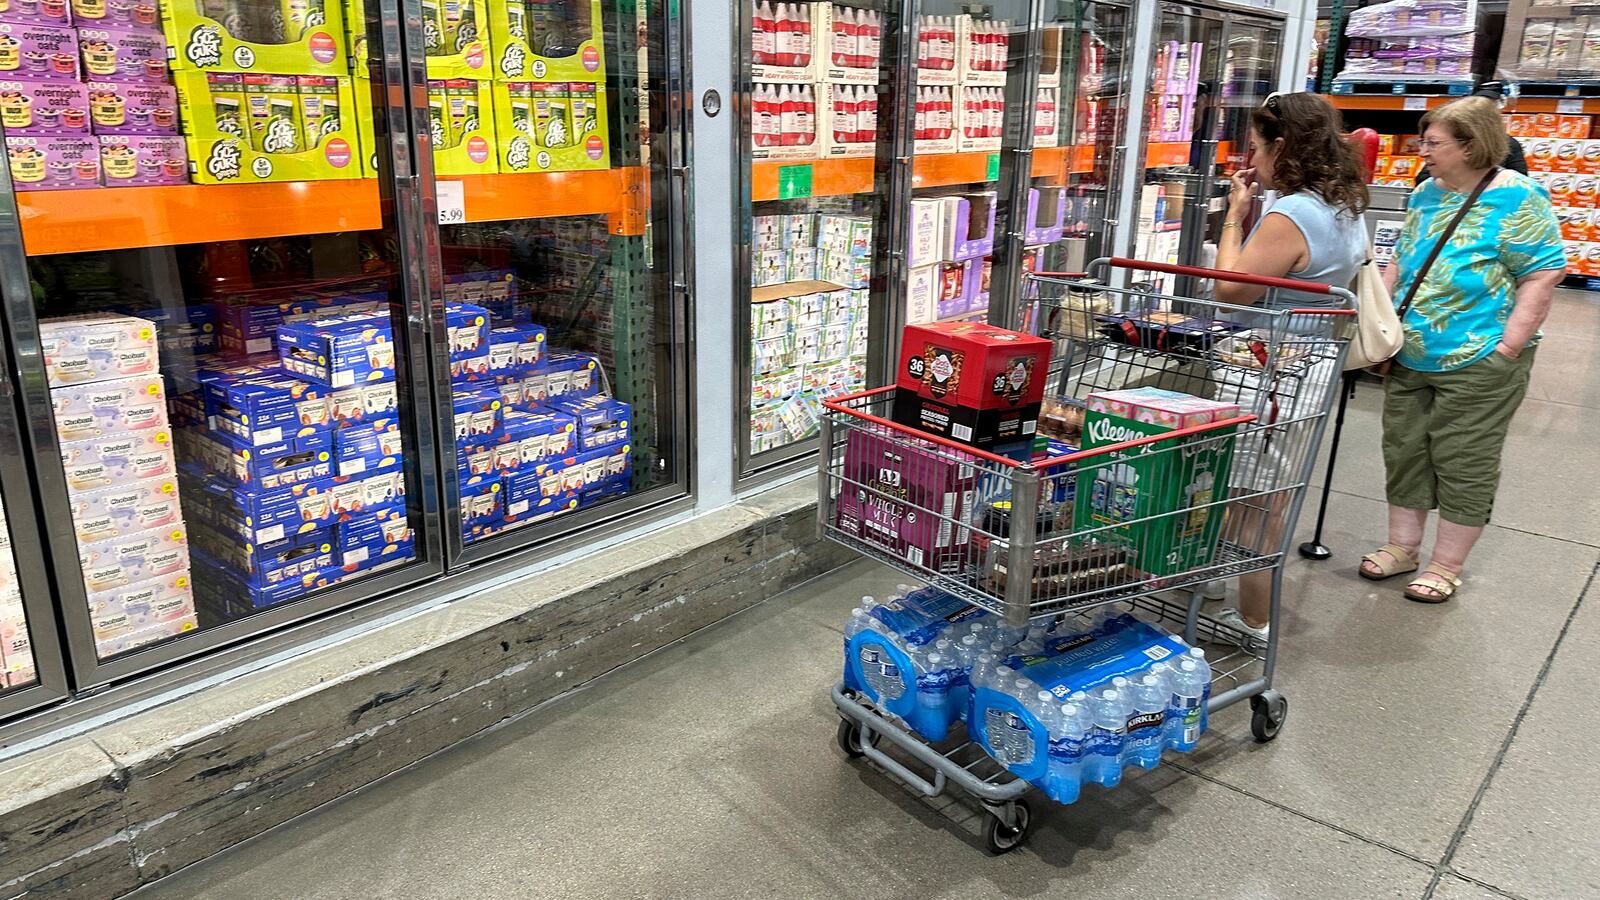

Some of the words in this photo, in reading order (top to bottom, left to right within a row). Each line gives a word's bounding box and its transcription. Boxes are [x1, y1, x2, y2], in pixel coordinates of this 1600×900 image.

[23, 32, 71, 45] overnight
[38, 43, 60, 52] oats
[119, 39, 161, 51] overnight
[132, 48, 151, 58] oats
[34, 89, 82, 101] overnight
[128, 89, 169, 101] overnight
[49, 98, 70, 108] oats
[141, 98, 160, 108] oats
[48, 142, 94, 153] overnight
[139, 140, 180, 152] overnight
[63, 151, 83, 161] oats
[910, 359, 923, 373] 36
[993, 375, 1006, 391] 36
[920, 410, 949, 423] SEASONED
[869, 494, 904, 519] WHOLE
[1166, 552, 1177, 565] 12
